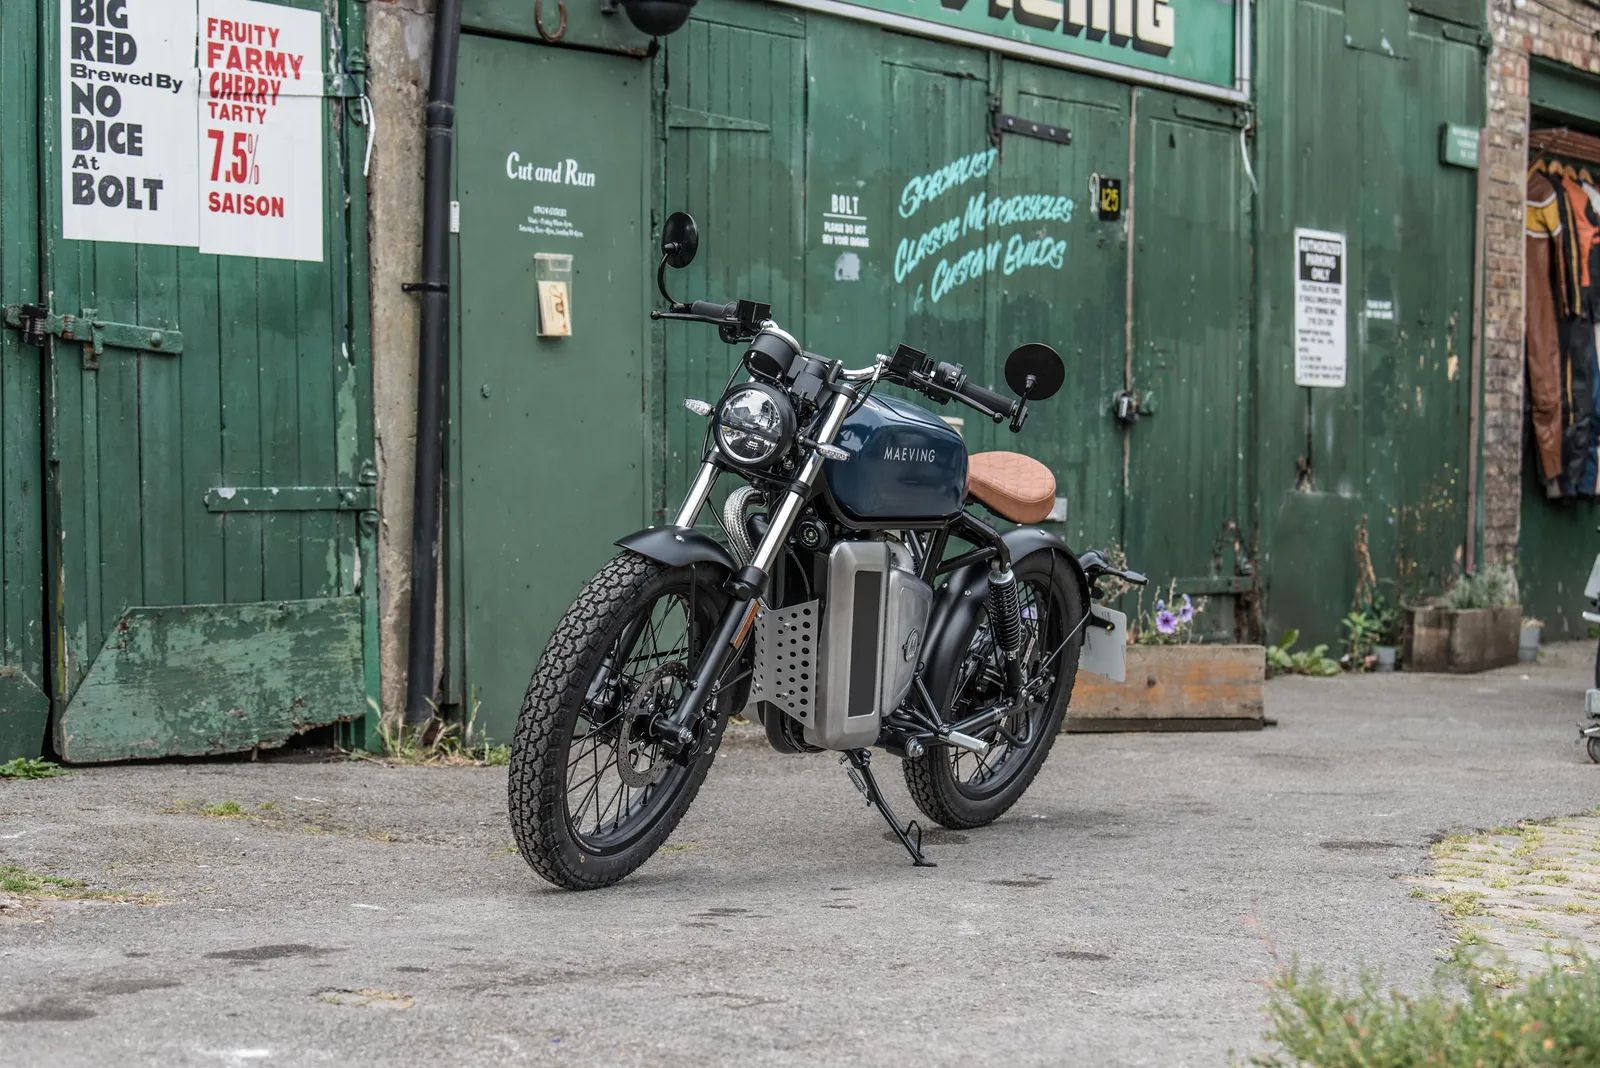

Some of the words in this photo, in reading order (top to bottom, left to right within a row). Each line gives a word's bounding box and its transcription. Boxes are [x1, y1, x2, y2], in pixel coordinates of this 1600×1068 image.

[71, 0, 128, 29] BIG
[71, 26, 137, 65] RED
[207, 17, 280, 48] FRUITY
[207, 42, 304, 80] FARMY
[71, 63, 153, 87] Brewed
[156, 74, 183, 94] By
[208, 71, 281, 106] CHERRY
[71, 81, 122, 117] NO
[207, 102, 266, 124] TARTY
[71, 117, 143, 156] DICE
[72, 154, 100, 171] At
[207, 129, 260, 185] 7.5%
[506, 151, 533, 182] Cut
[535, 161, 562, 184] and
[565, 158, 596, 187] Run
[72, 172, 163, 211] BOLT
[208, 191, 285, 218] SAISON
[831, 193, 859, 215] BOLT
[883, 446, 936, 463] MAEVING
